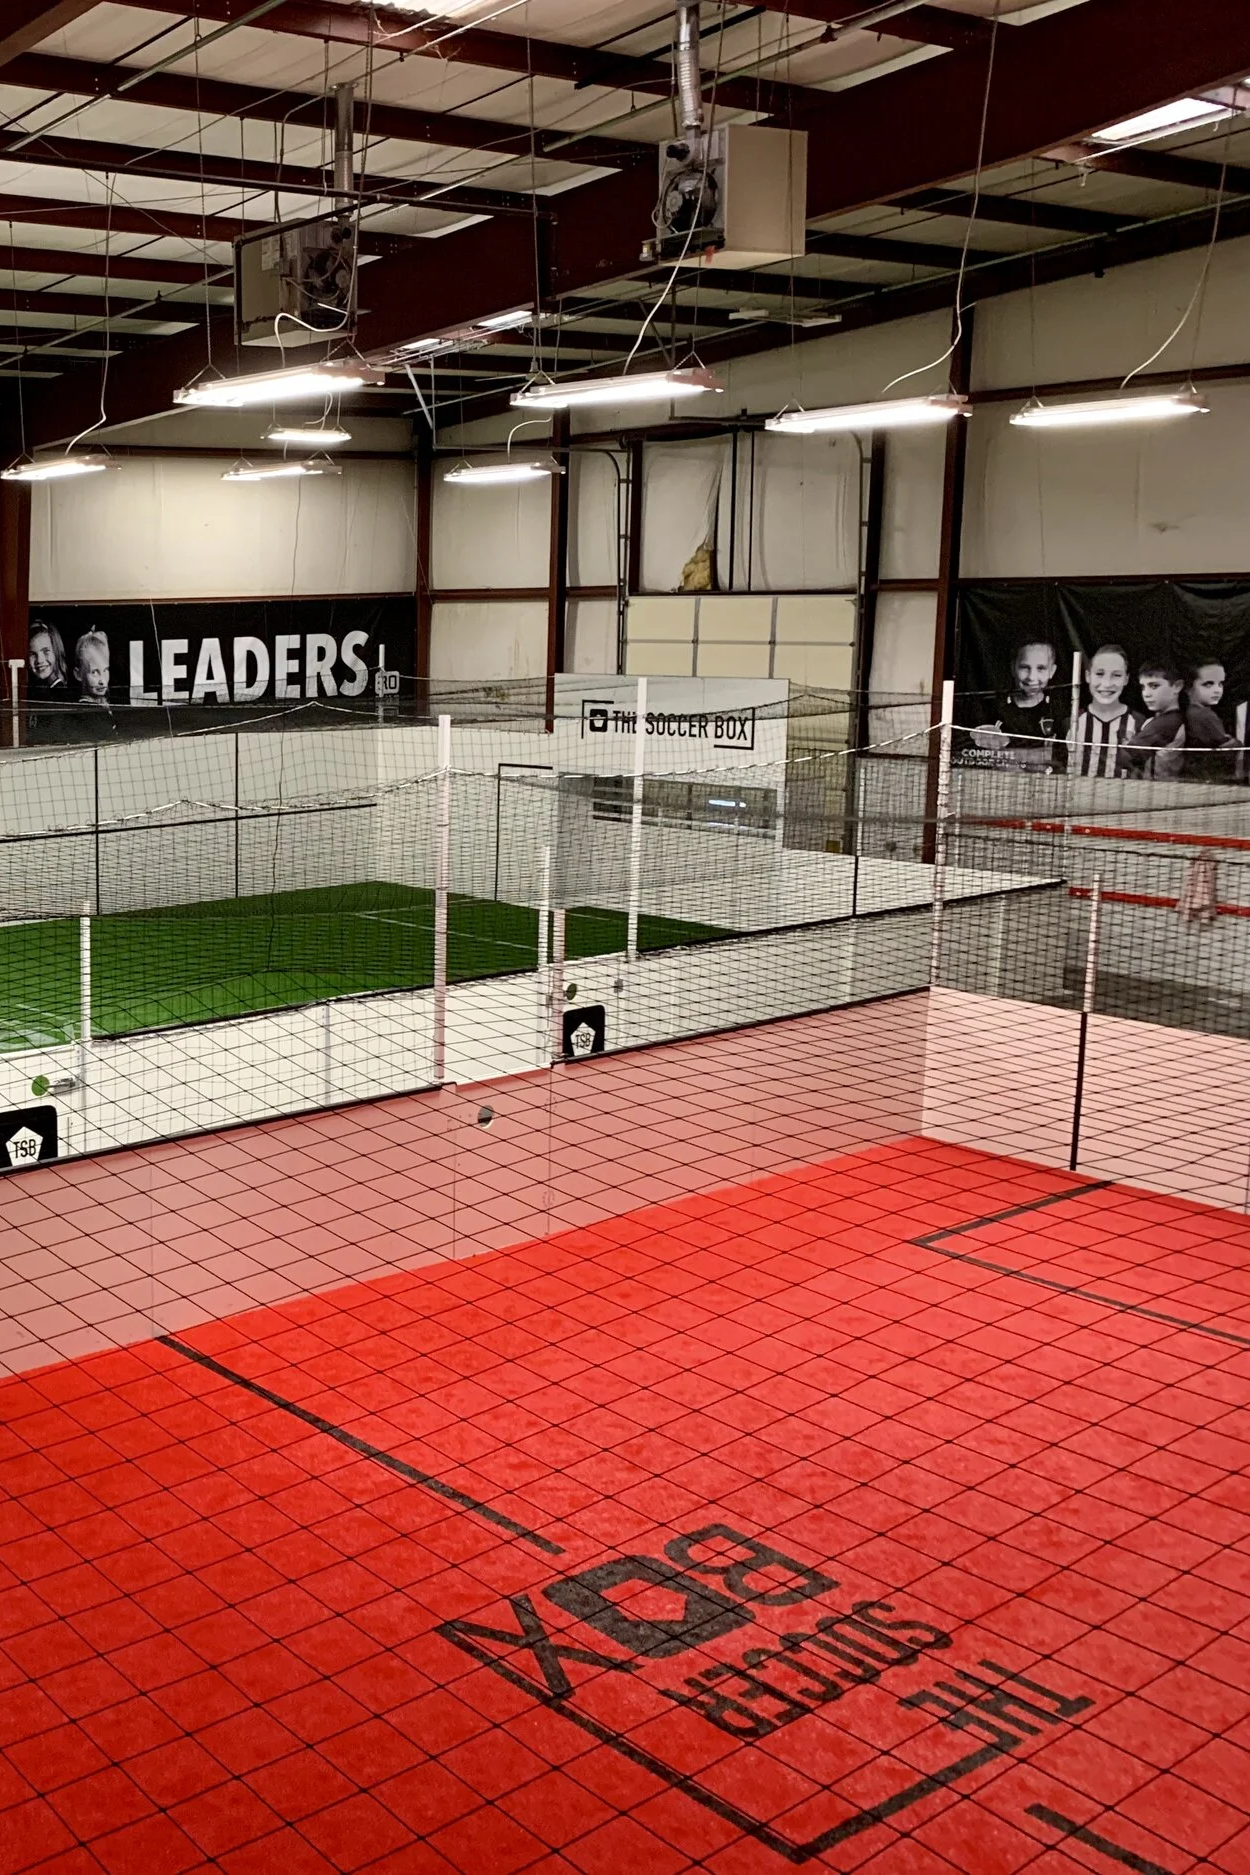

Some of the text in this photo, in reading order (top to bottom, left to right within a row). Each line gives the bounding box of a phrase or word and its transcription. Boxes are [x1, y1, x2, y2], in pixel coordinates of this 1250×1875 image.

[129, 630, 370, 707] LEADERS
[645, 712, 708, 739] SOCCER
[714, 715, 748, 741] BOX
[961, 748, 1016, 760] COMPLETE
[575, 1033, 591, 1049] TSB
[13, 1138, 37, 1159] TSB
[435, 1523, 841, 1700] BOX
[659, 1600, 954, 1738] SOCCER
[897, 1659, 1097, 1750] THE
